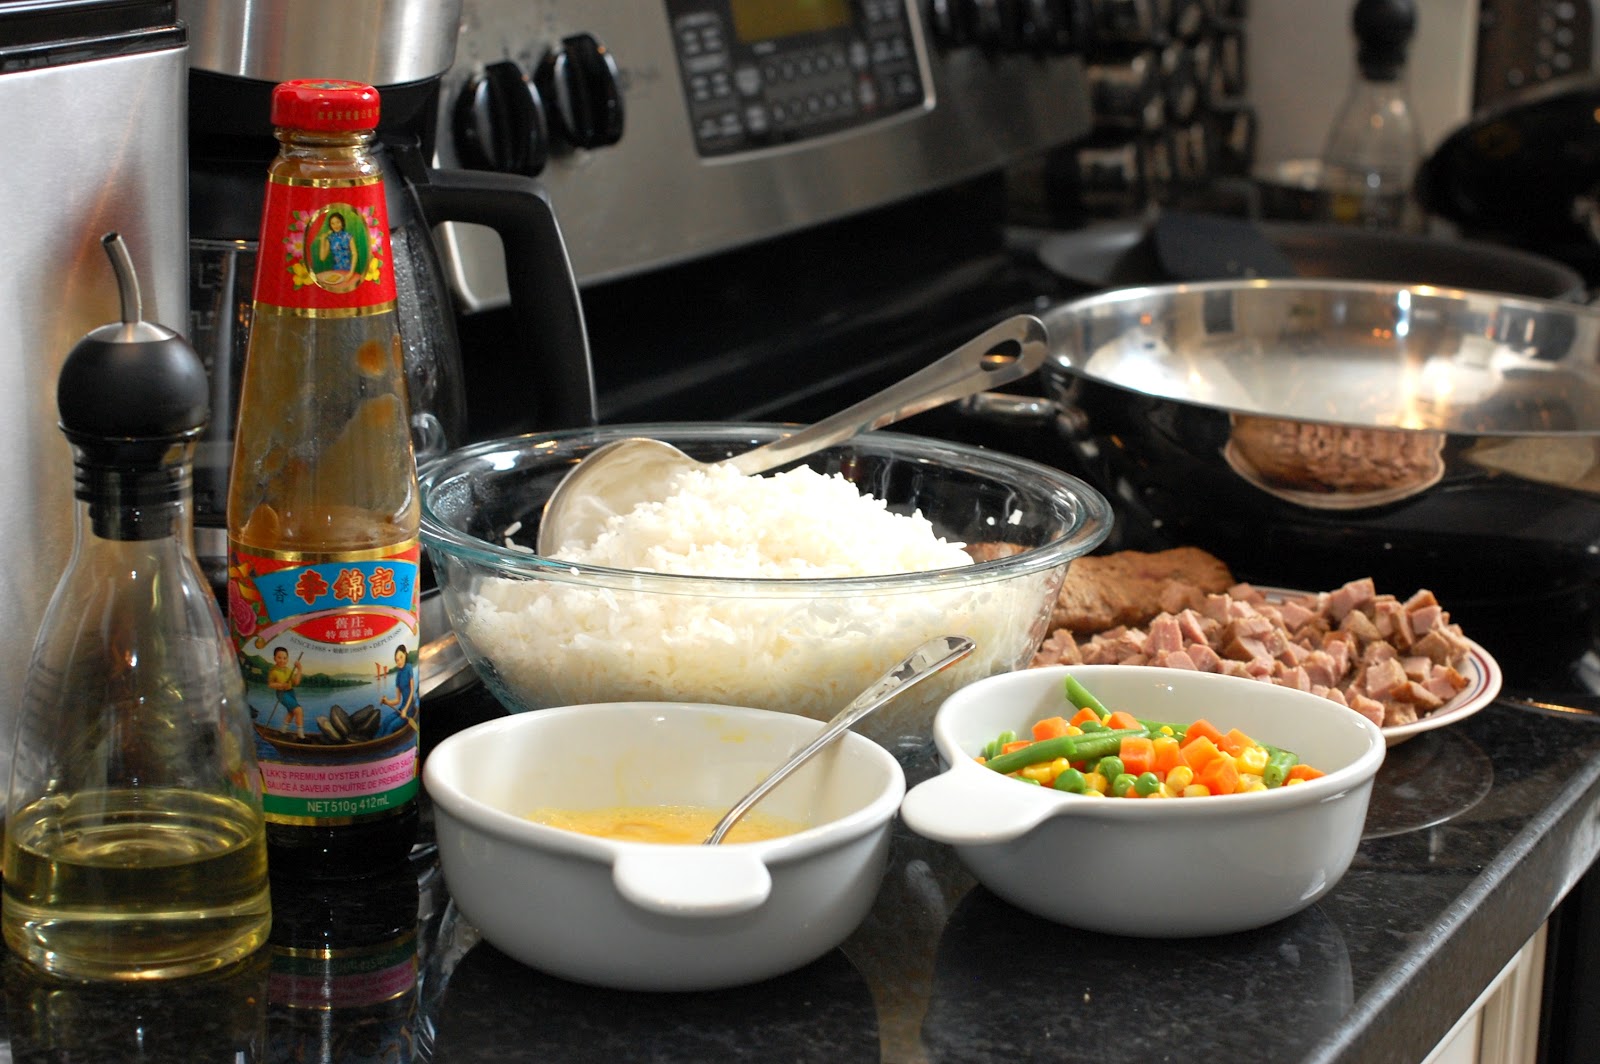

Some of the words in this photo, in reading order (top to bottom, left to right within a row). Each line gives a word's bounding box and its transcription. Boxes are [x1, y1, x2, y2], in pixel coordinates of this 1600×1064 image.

[266, 769, 287, 779] LKK'S
[289, 772, 326, 781] PREMIUM
[328, 771, 360, 781] OYSTER
[361, 762, 400, 777] FLAVOURED
[267, 780, 291, 791] SAUCE
[300, 784, 330, 793] SAVEUR
[367, 780, 377, 789] DE
[307, 801, 329, 813] NET
[331, 802, 357, 813] 510g
[359, 796, 389, 809] 412mL
